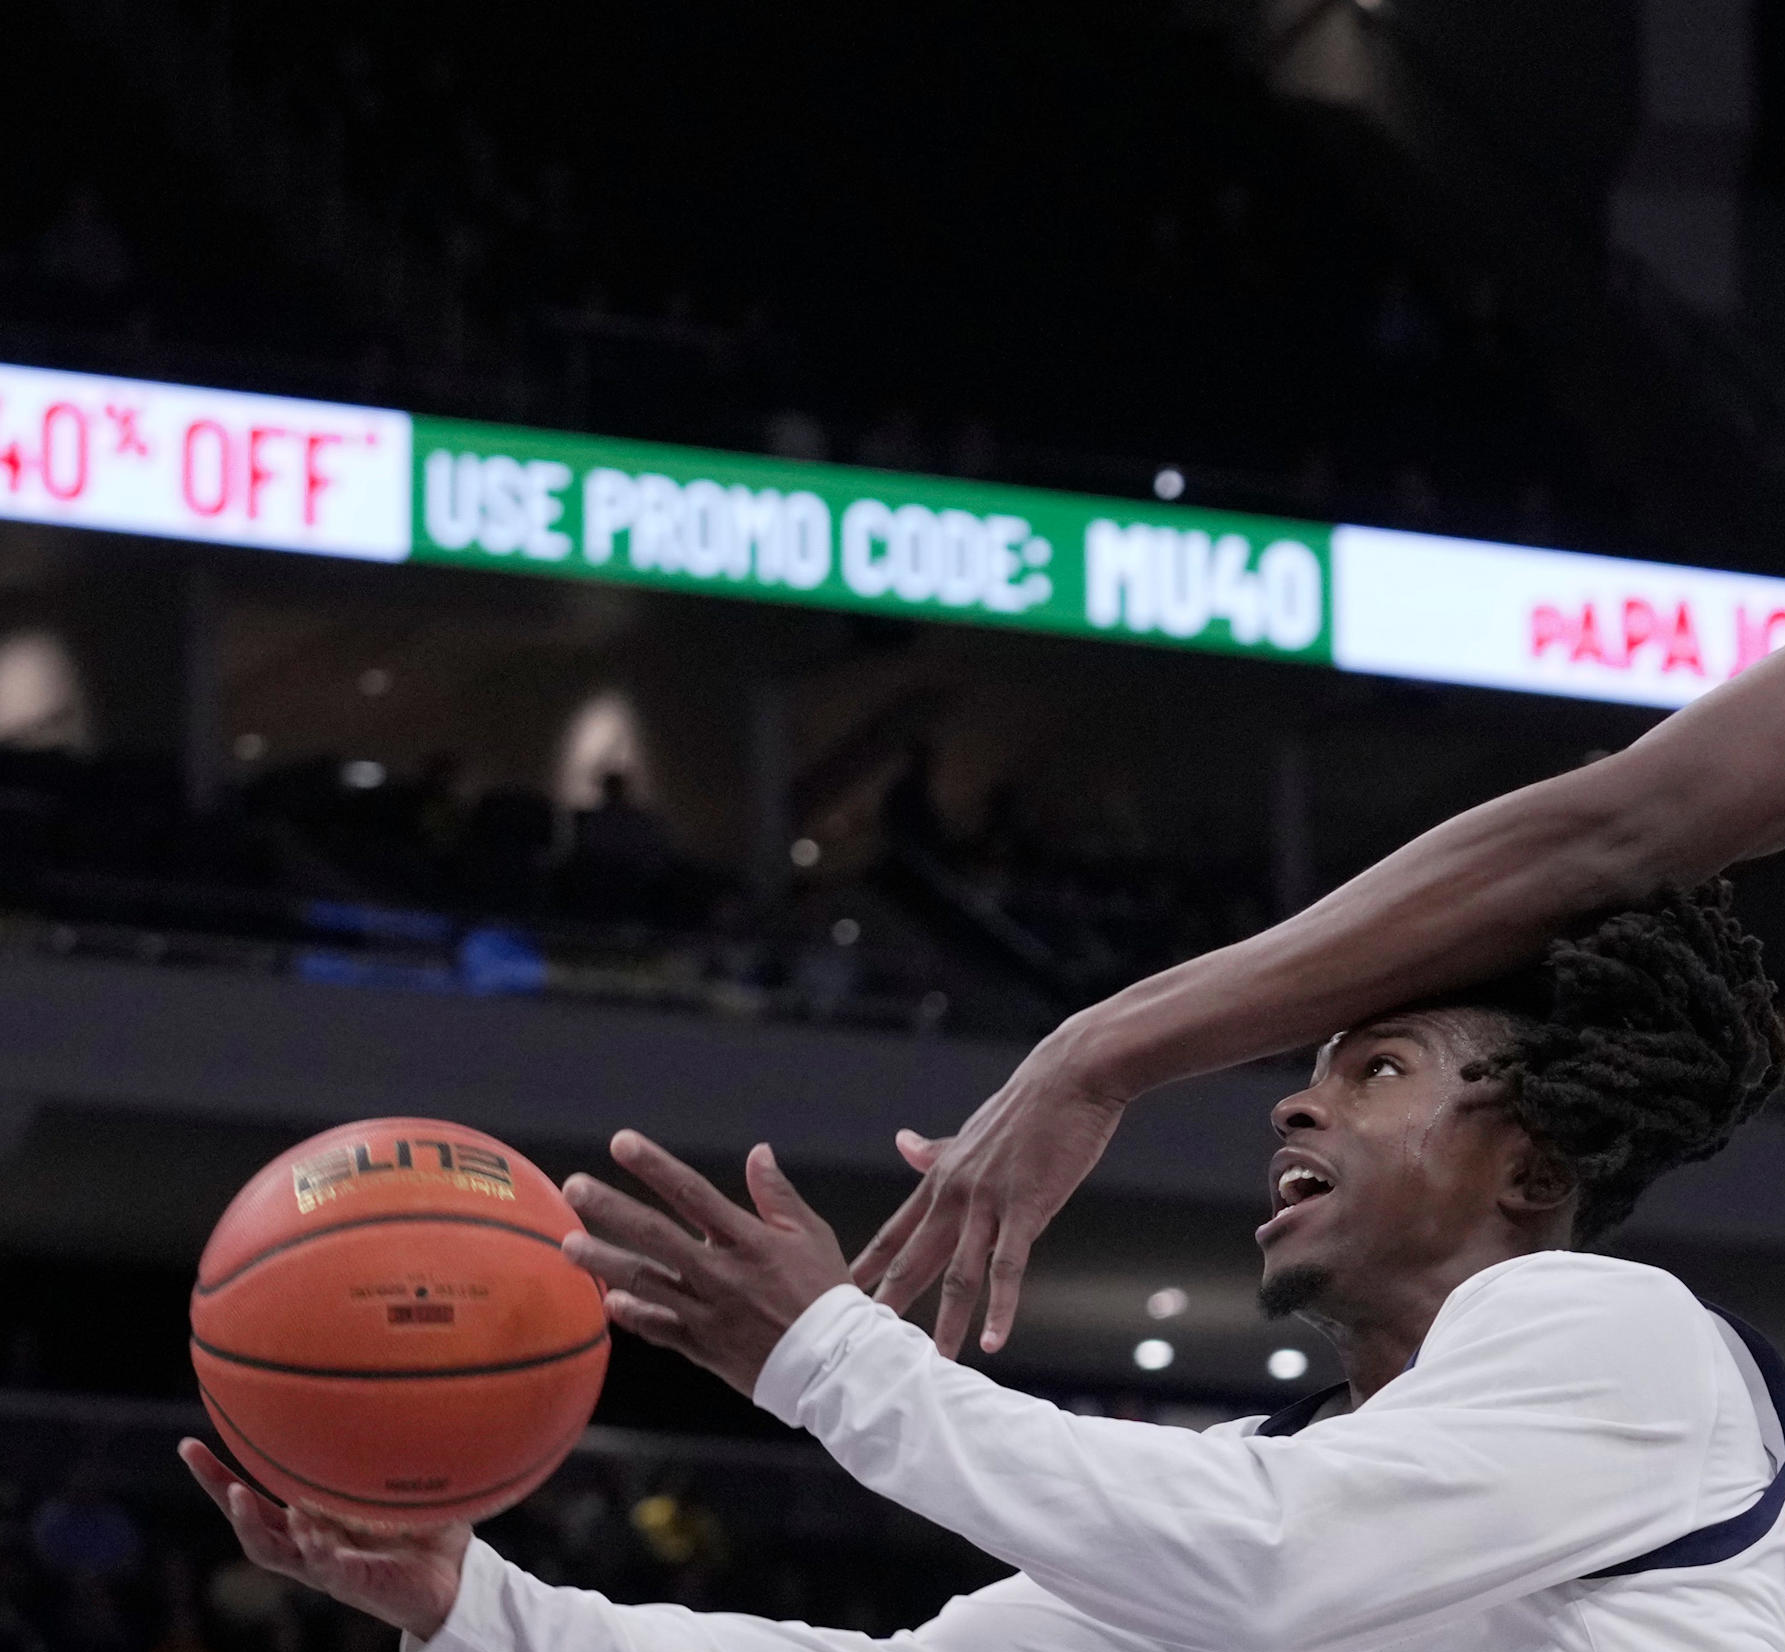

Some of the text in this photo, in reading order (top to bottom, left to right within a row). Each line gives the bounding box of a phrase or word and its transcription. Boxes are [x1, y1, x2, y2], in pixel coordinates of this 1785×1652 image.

[424, 448, 1322, 651] USE PROMO CODE: MU40
[1531, 597, 1704, 678] PAPA
